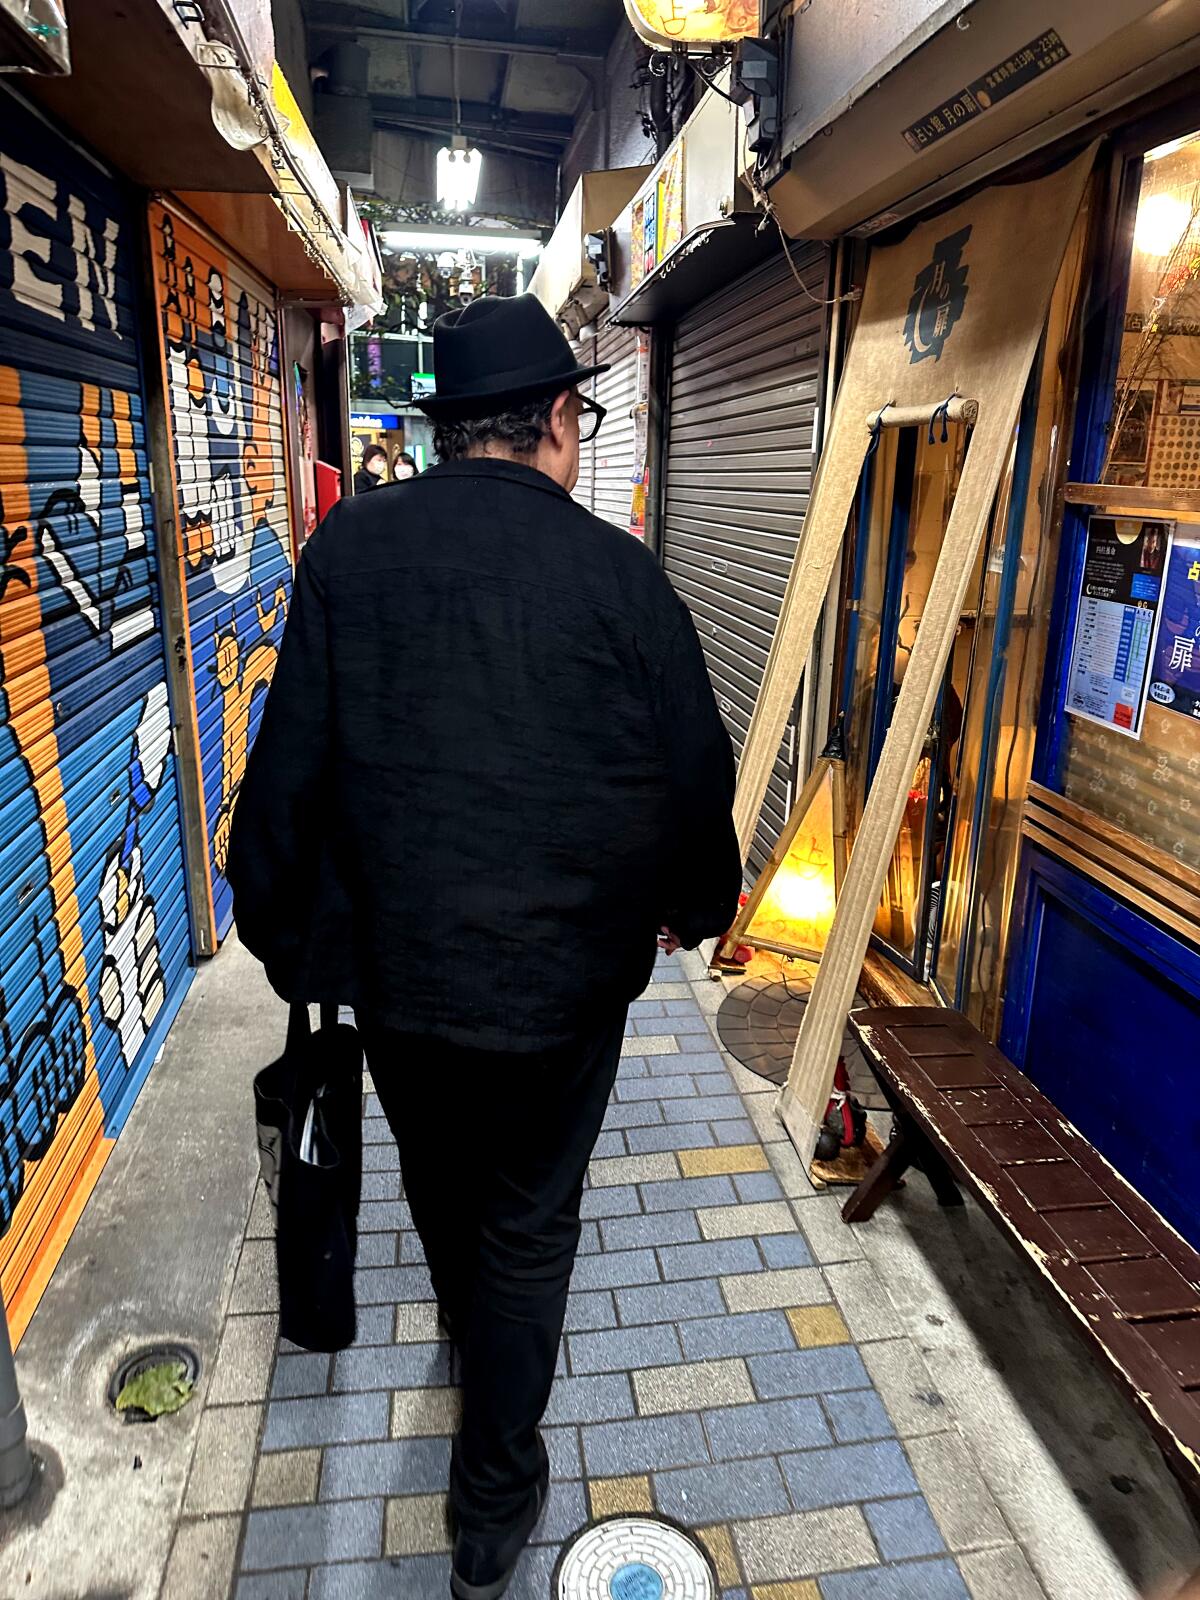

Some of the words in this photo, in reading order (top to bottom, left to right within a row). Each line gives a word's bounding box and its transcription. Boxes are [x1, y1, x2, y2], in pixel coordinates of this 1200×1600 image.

[943, 93, 977, 126] 月の扉
[929, 260, 952, 338] 月の扉
